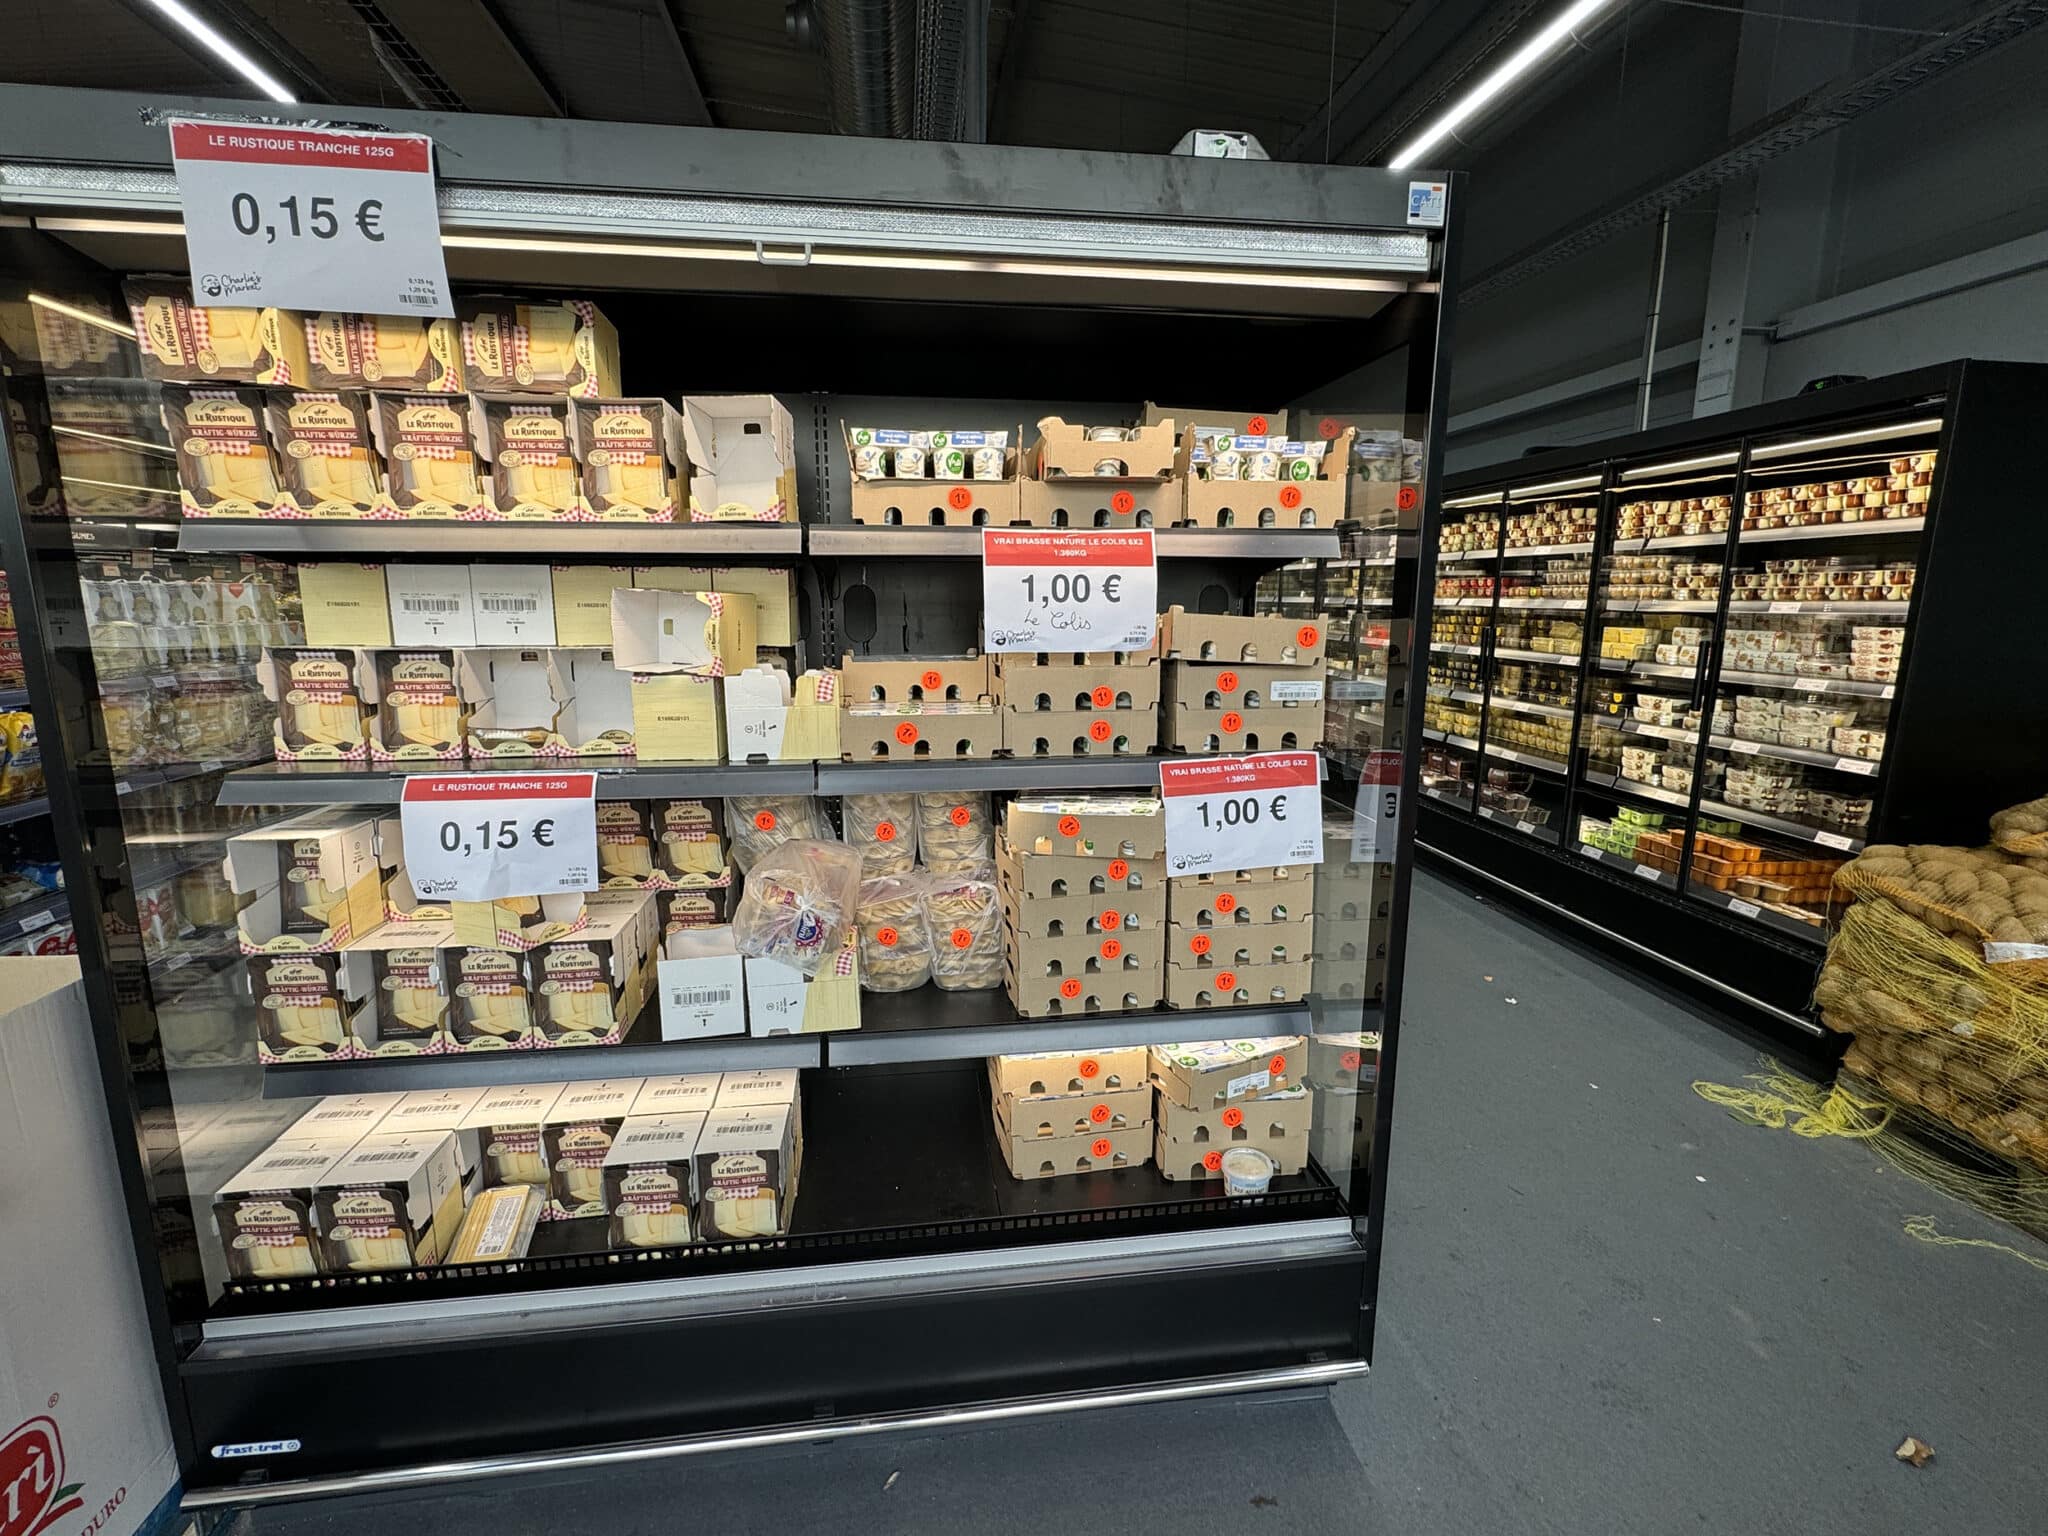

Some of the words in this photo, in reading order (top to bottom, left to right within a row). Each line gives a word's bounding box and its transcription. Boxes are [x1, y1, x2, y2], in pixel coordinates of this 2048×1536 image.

[209, 135, 227, 146] LE
[229, 136, 295, 151] RUSTIQUE
[299, 140, 361, 156] TRANCHE
[365, 146, 394, 157] 125G
[231, 192, 339, 244] 0,15
[355, 199, 385, 242] €
[221, 271, 262, 288] Charlie's
[224, 283, 262, 298] Market
[161, 303, 176, 348] RUSTIQUE
[331, 318, 344, 357] RUSTIQUE
[487, 321, 498, 359] RUSTIQUE
[171, 348, 178, 357] LE
[337, 359, 345, 367] LE
[492, 360, 499, 369] LE
[195, 414, 204, 422] LE
[206, 413, 247, 423] RUSTIQUE
[298, 416, 307, 424] LE
[308, 415, 348, 425] RUSTIQUE
[406, 419, 414, 428] LE
[415, 419, 454, 429] RUSTIQUE
[511, 428, 520, 436] LE
[520, 427, 557, 437] RUSTIQUE
[600, 427, 609, 436] LE
[609, 426, 645, 436] RUSTIQUE
[993, 537, 1014, 546] VRAI
[1016, 537, 1050, 546] BRASSE
[1053, 537, 1087, 546] NATURE
[1088, 538, 1100, 546] LE
[1101, 538, 1127, 546] COLIS
[1021, 574, 1091, 609] 1,00
[1101, 574, 1122, 603] €
[298, 670, 306, 678] LE
[307, 669, 341, 679] RUSTIQUE
[409, 671, 443, 680] RUSTIQUE
[1169, 768, 1189, 777] VRAI
[1190, 765, 1222, 775] BRASSE
[1223, 762, 1255, 772] NATURE
[1256, 761, 1266, 769] LE
[1267, 760, 1291, 769] COLIS
[1292, 759, 1309, 767] 6X2
[431, 783, 446, 792] LE
[447, 782, 495, 791] RUSTIQUE
[498, 781, 543, 790] TRANCHE
[546, 781, 568, 790] 125G
[1197, 797, 1260, 832] 1,00
[1269, 795, 1288, 822] €
[440, 820, 519, 857] 0,15
[531, 819, 555, 847] €
[402, 956, 435, 964] RUSTIQUE
[559, 960, 593, 968] RUSTIQUE
[476, 962, 511, 970] RUSTIQUE
[283, 974, 321, 982] RUSTIQUE
[726, 1166, 761, 1174] RUSTIQUE
[636, 1182, 671, 1190] RUSTIQUE
[350, 1206, 387, 1214] RUSTIQUE
[253, 1215, 291, 1223] RUSTIQUE
